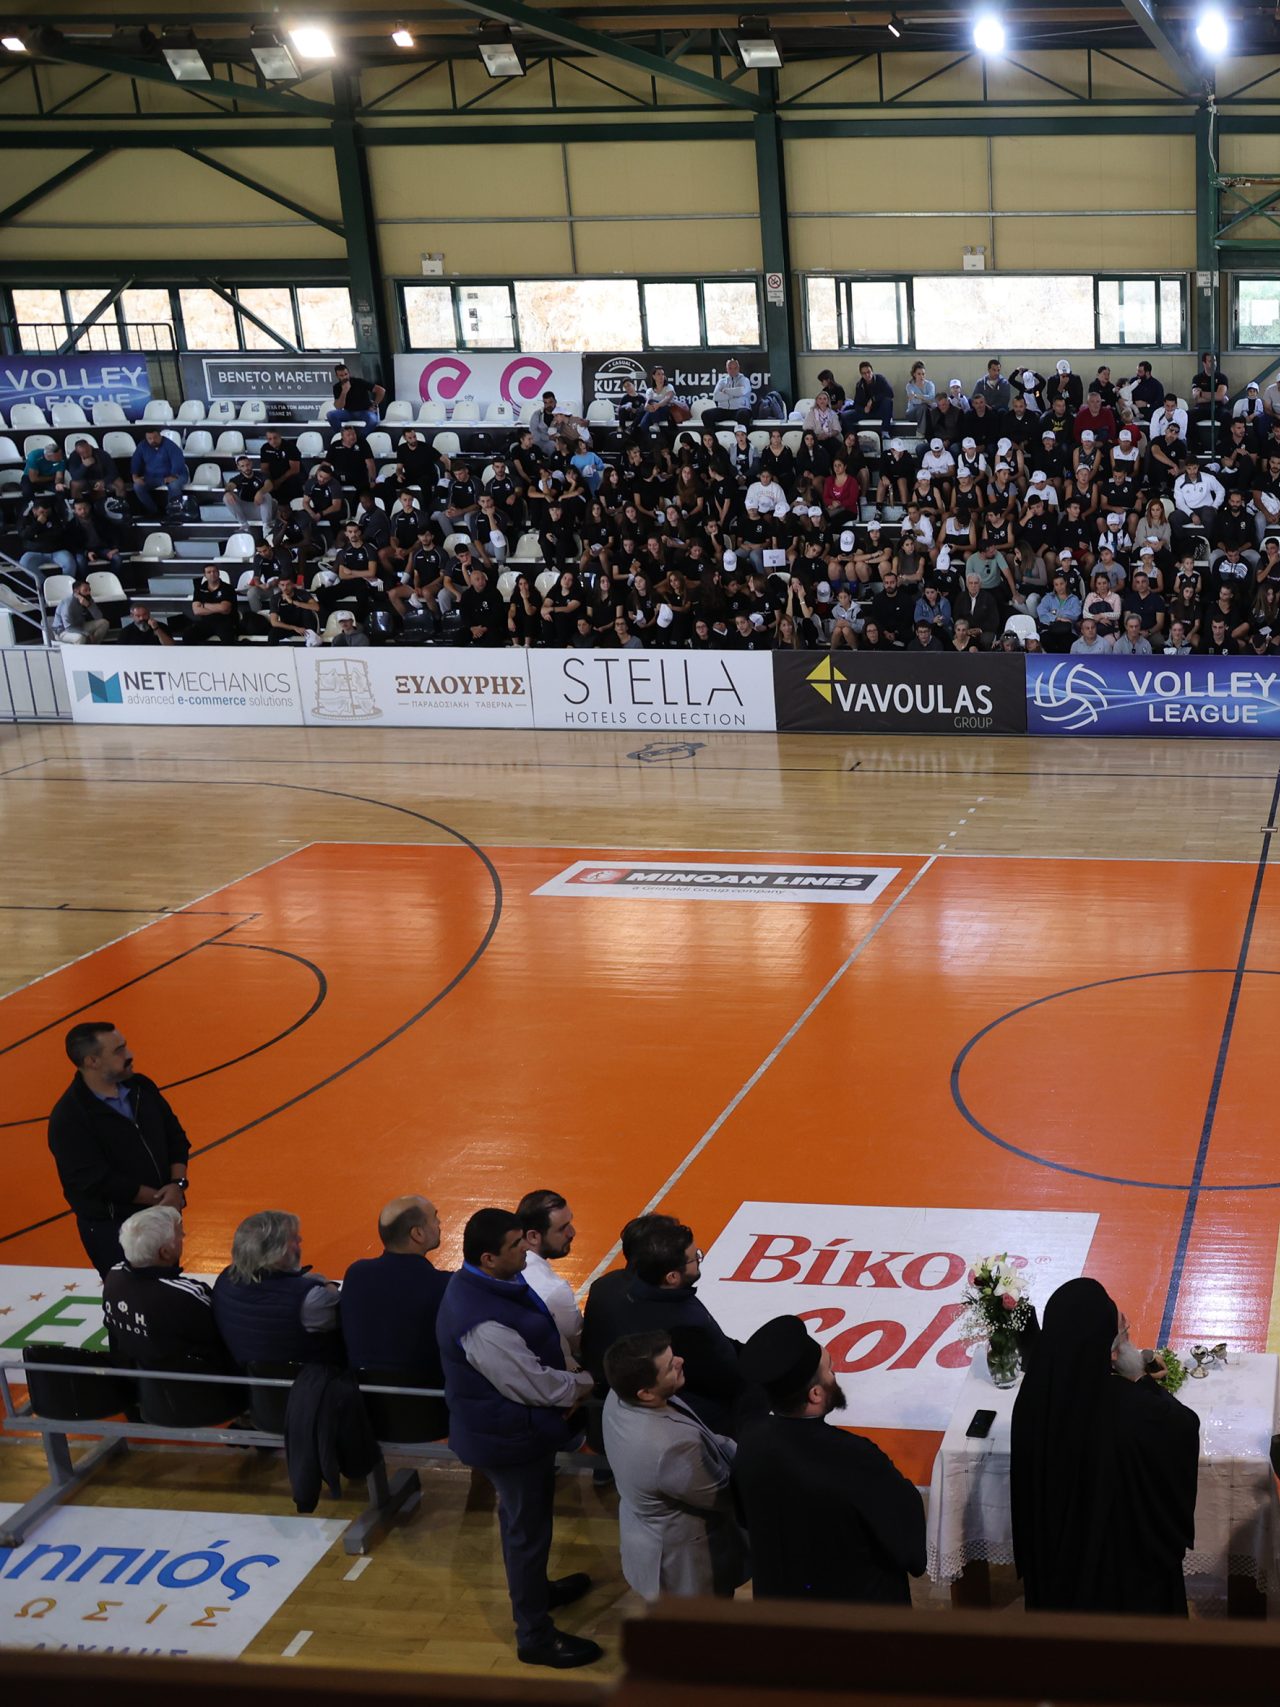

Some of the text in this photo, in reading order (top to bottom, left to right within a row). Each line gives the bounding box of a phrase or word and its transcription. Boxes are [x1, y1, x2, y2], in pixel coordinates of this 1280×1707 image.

[5, 366, 142, 391] VOLLEY
[218, 371, 333, 383] BENETO MARETTI
[124, 671, 291, 693] NETMECHANICS
[395, 676, 525, 695] ΞΥΛΟΥΡΗΣ
[563, 658, 744, 706] STELLA
[1128, 671, 1277, 698] VOLLEY
[127, 694, 294, 707] advanced e-commerce solutions
[412, 700, 513, 709] ΠΑΡΑΔΟΣΙΑΚΗ ΤΑΒΕΡΝΑ
[835, 683, 993, 715] VAVOULAS
[565, 711, 746, 726] HOTELS COLLECTION
[953, 716, 993, 729] GROUP
[1148, 704, 1258, 724] LEAGUE
[626, 872, 866, 888] MINOAN LINES
